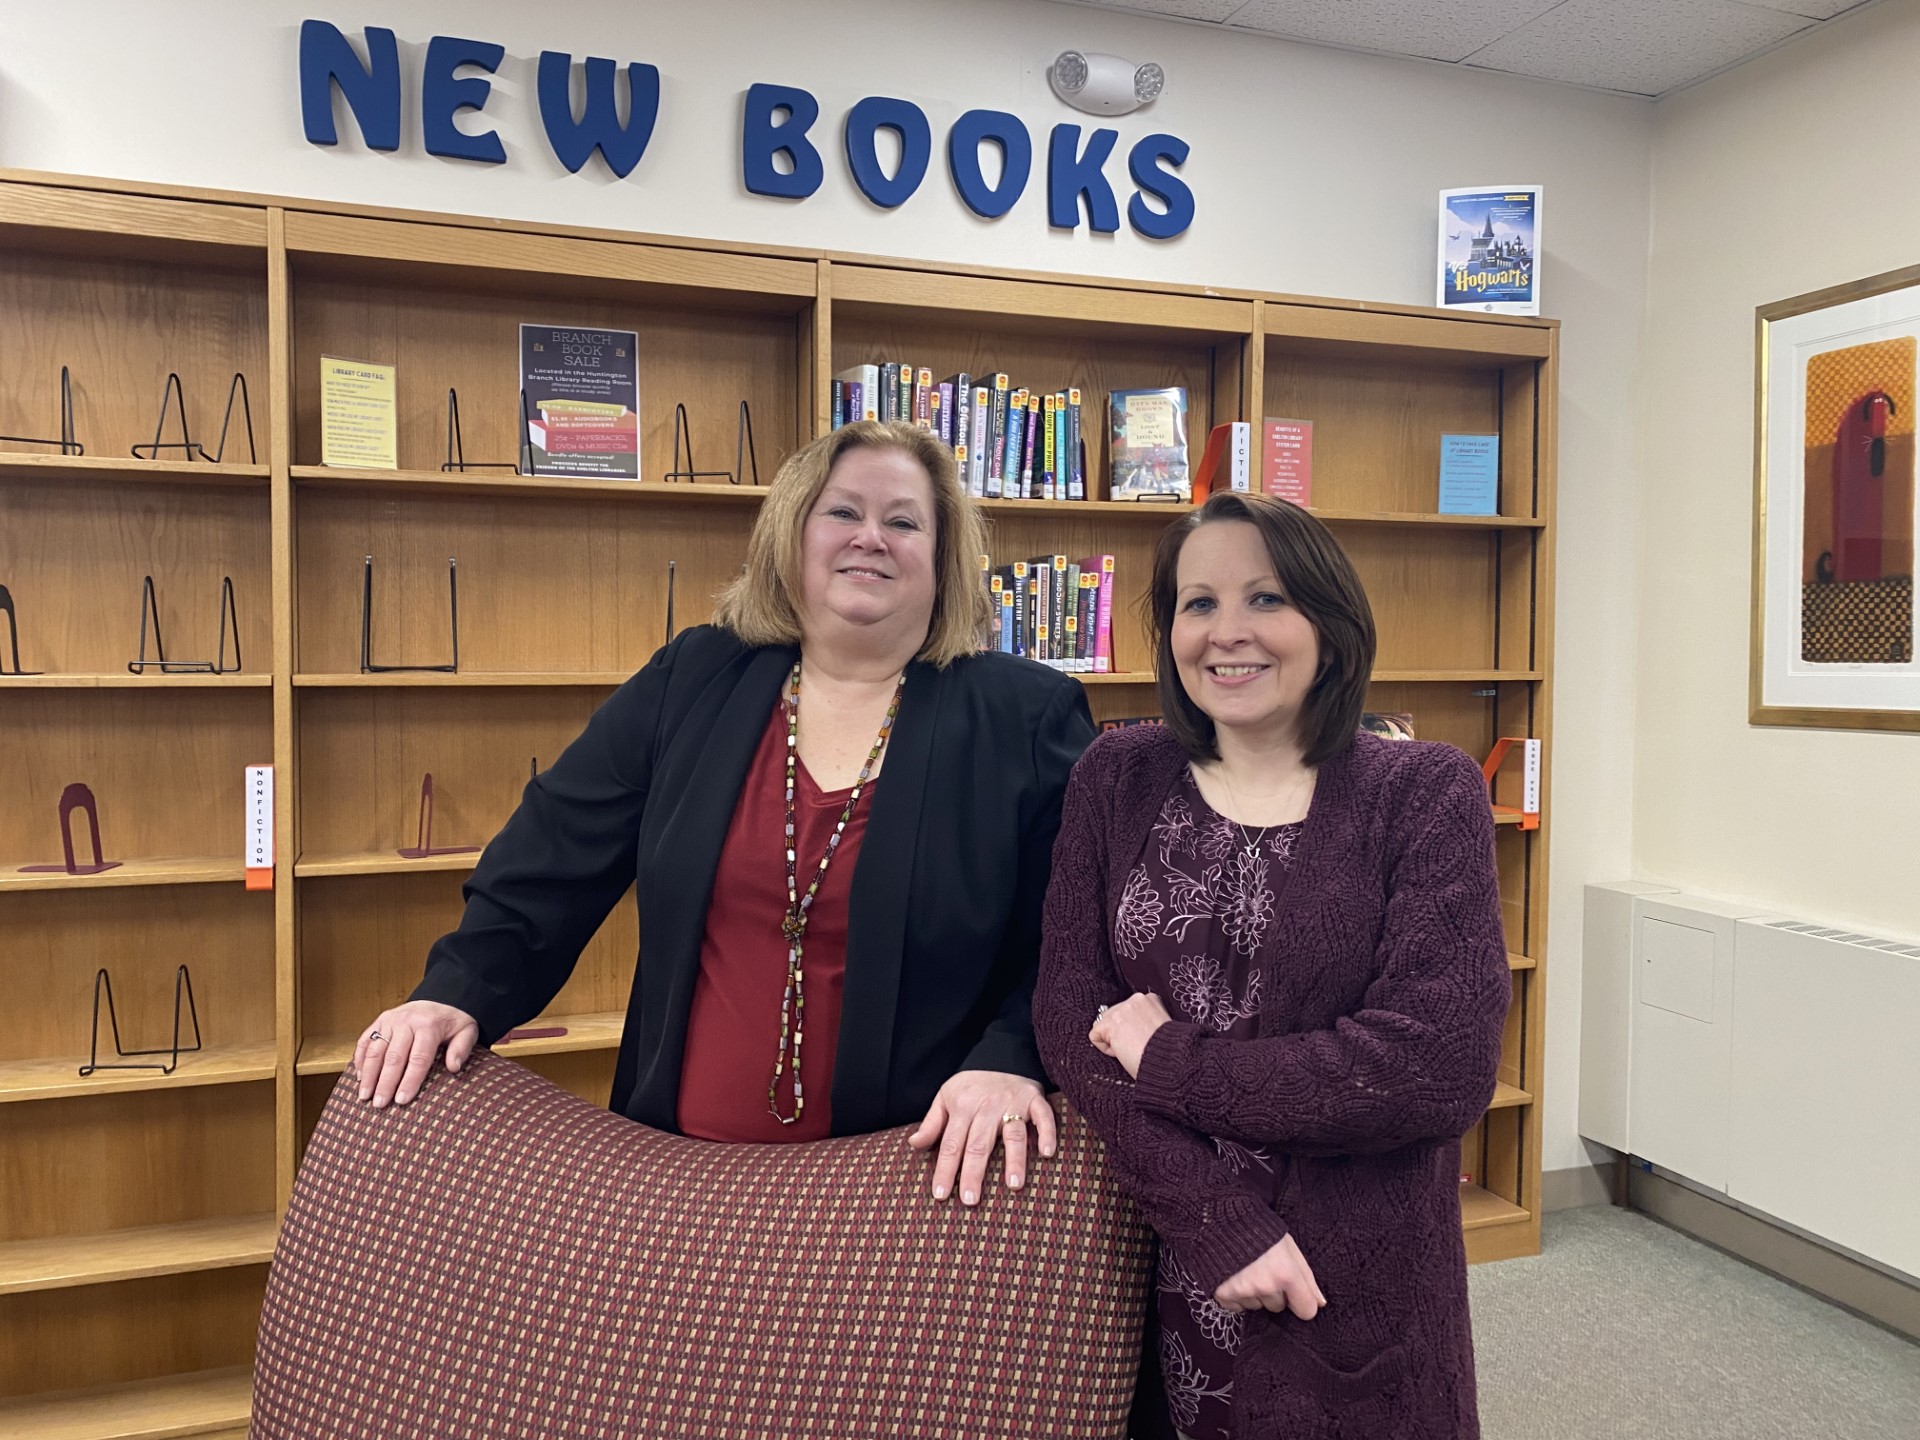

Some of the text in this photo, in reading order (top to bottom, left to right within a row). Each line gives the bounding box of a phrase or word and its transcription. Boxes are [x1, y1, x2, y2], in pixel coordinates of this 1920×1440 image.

[300, 19, 1196, 239] NEW BOOKS
[1454, 268, 1528, 292] Hogwarts
[552, 332, 612, 346] BRANCH
[562, 344, 602, 356] BOOK
[564, 356, 600, 367] SALE
[959, 406, 968, 445] Glutton
